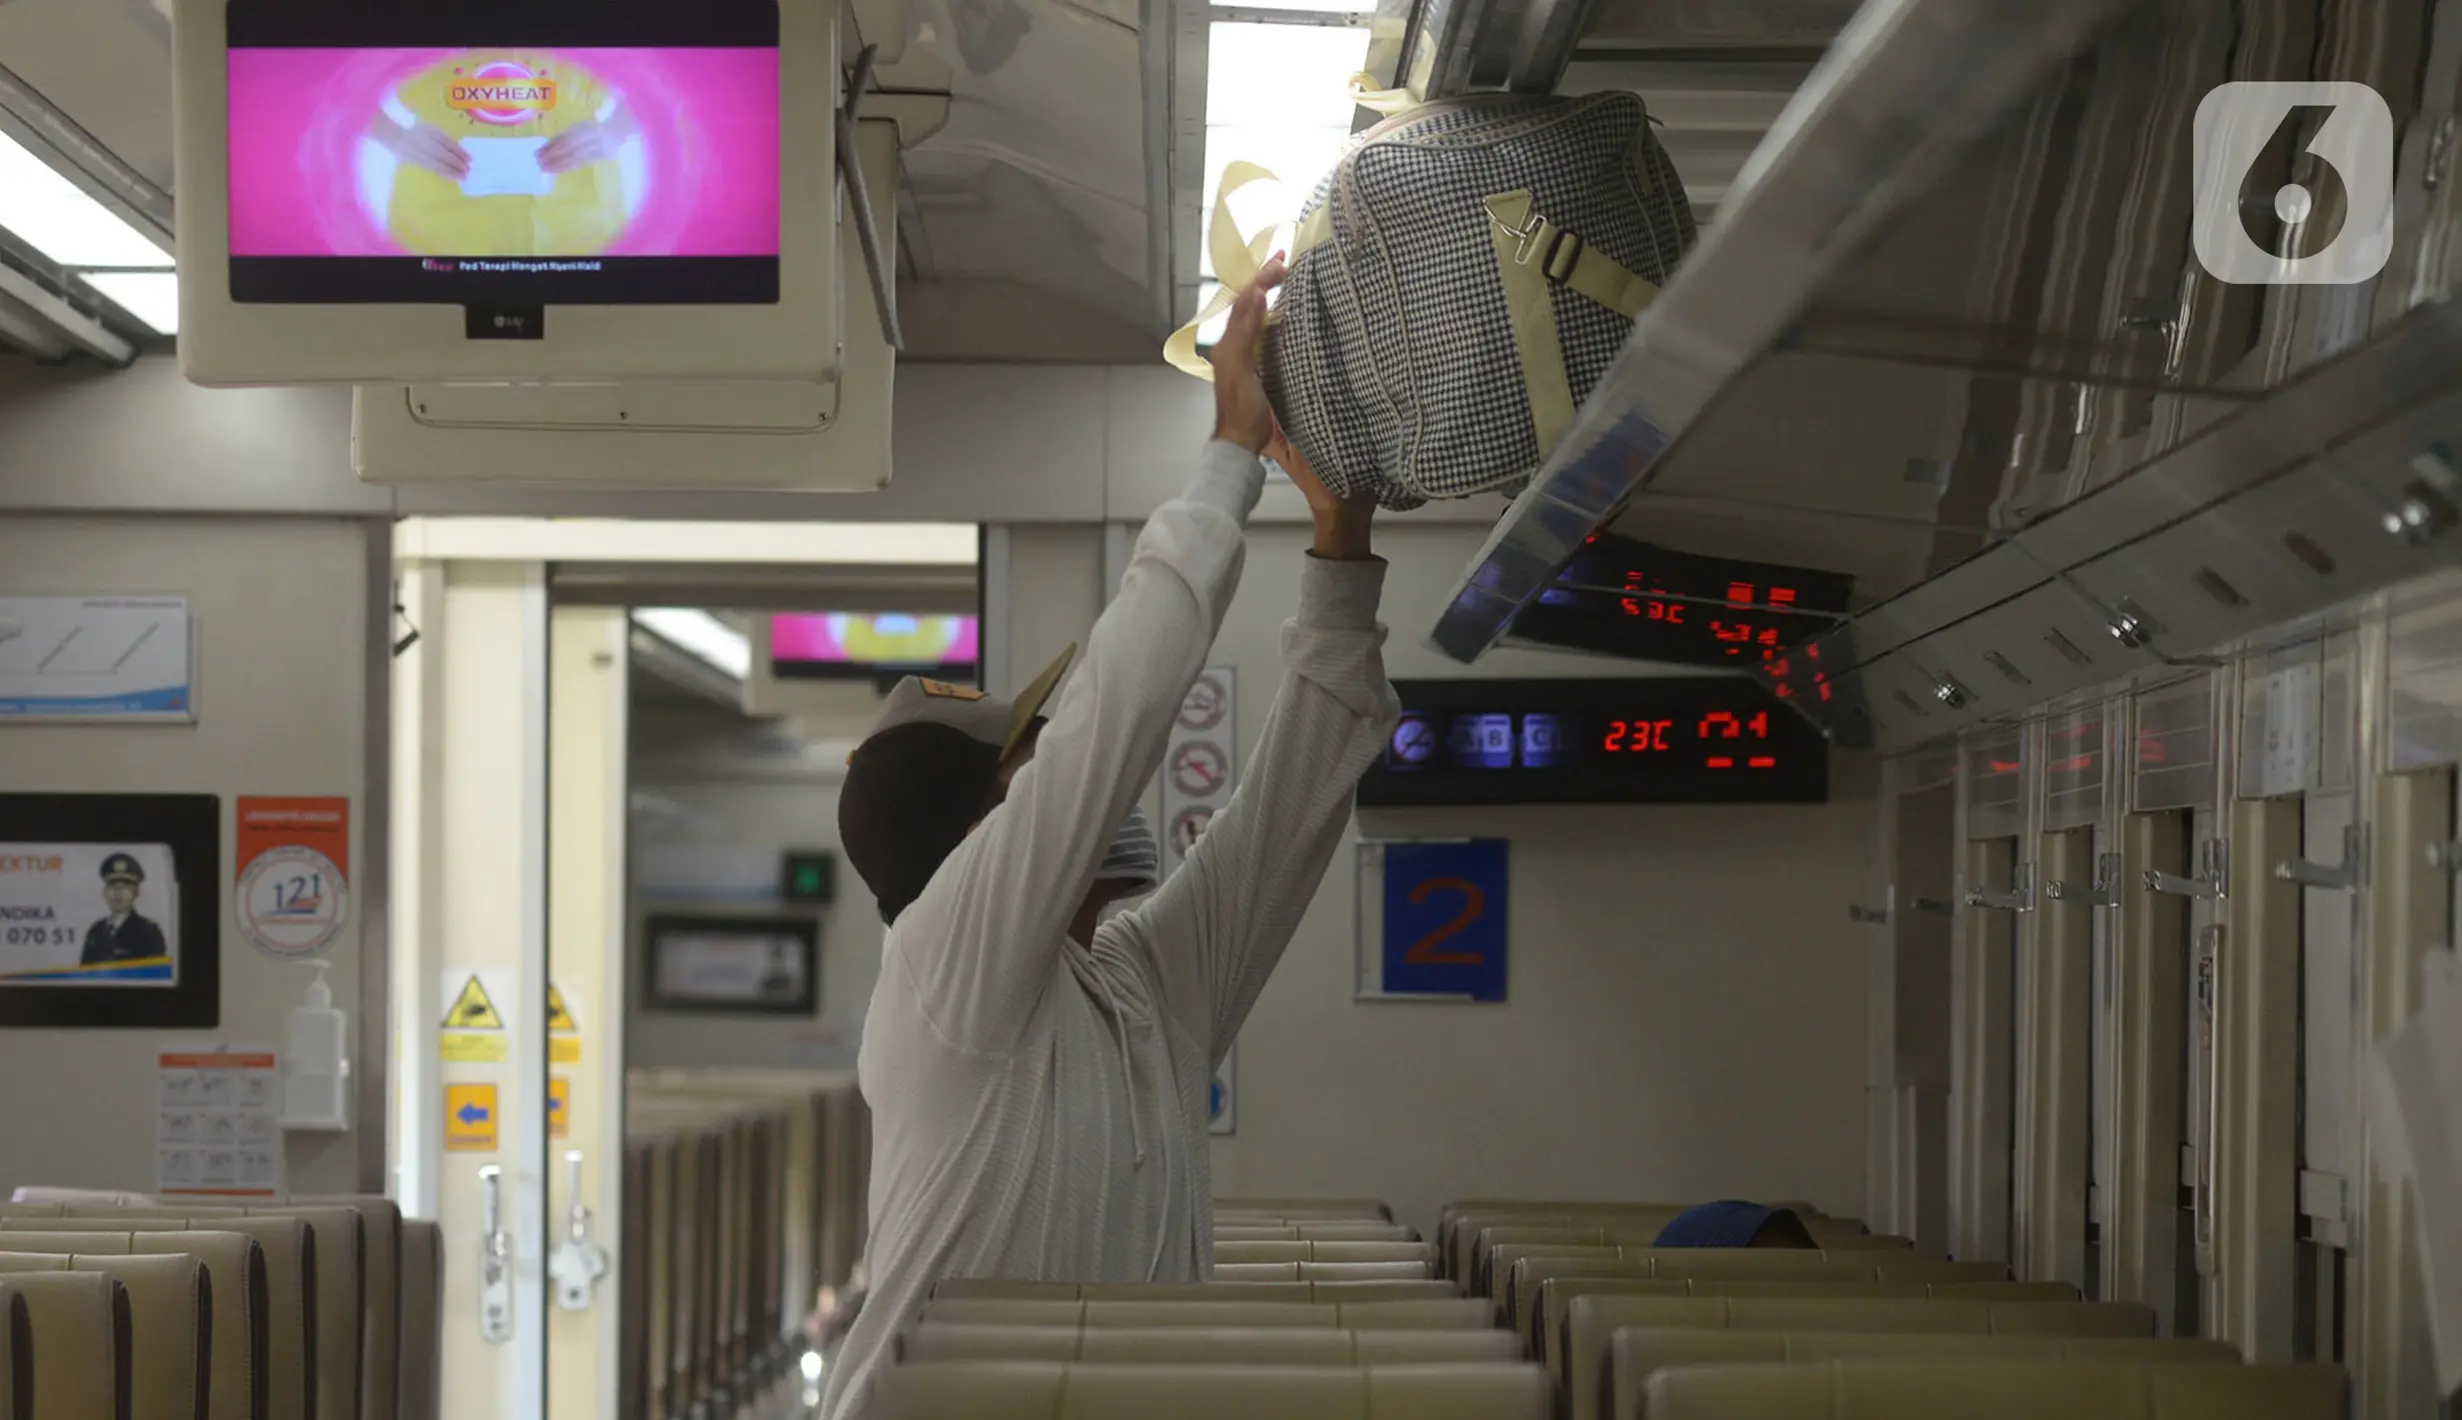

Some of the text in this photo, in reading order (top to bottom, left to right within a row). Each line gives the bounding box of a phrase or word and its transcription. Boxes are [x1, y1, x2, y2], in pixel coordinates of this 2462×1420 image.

[451, 86, 551, 100] OXYHEAT
[272, 873, 321, 910] 121
[1405, 877, 1485, 963] 2
